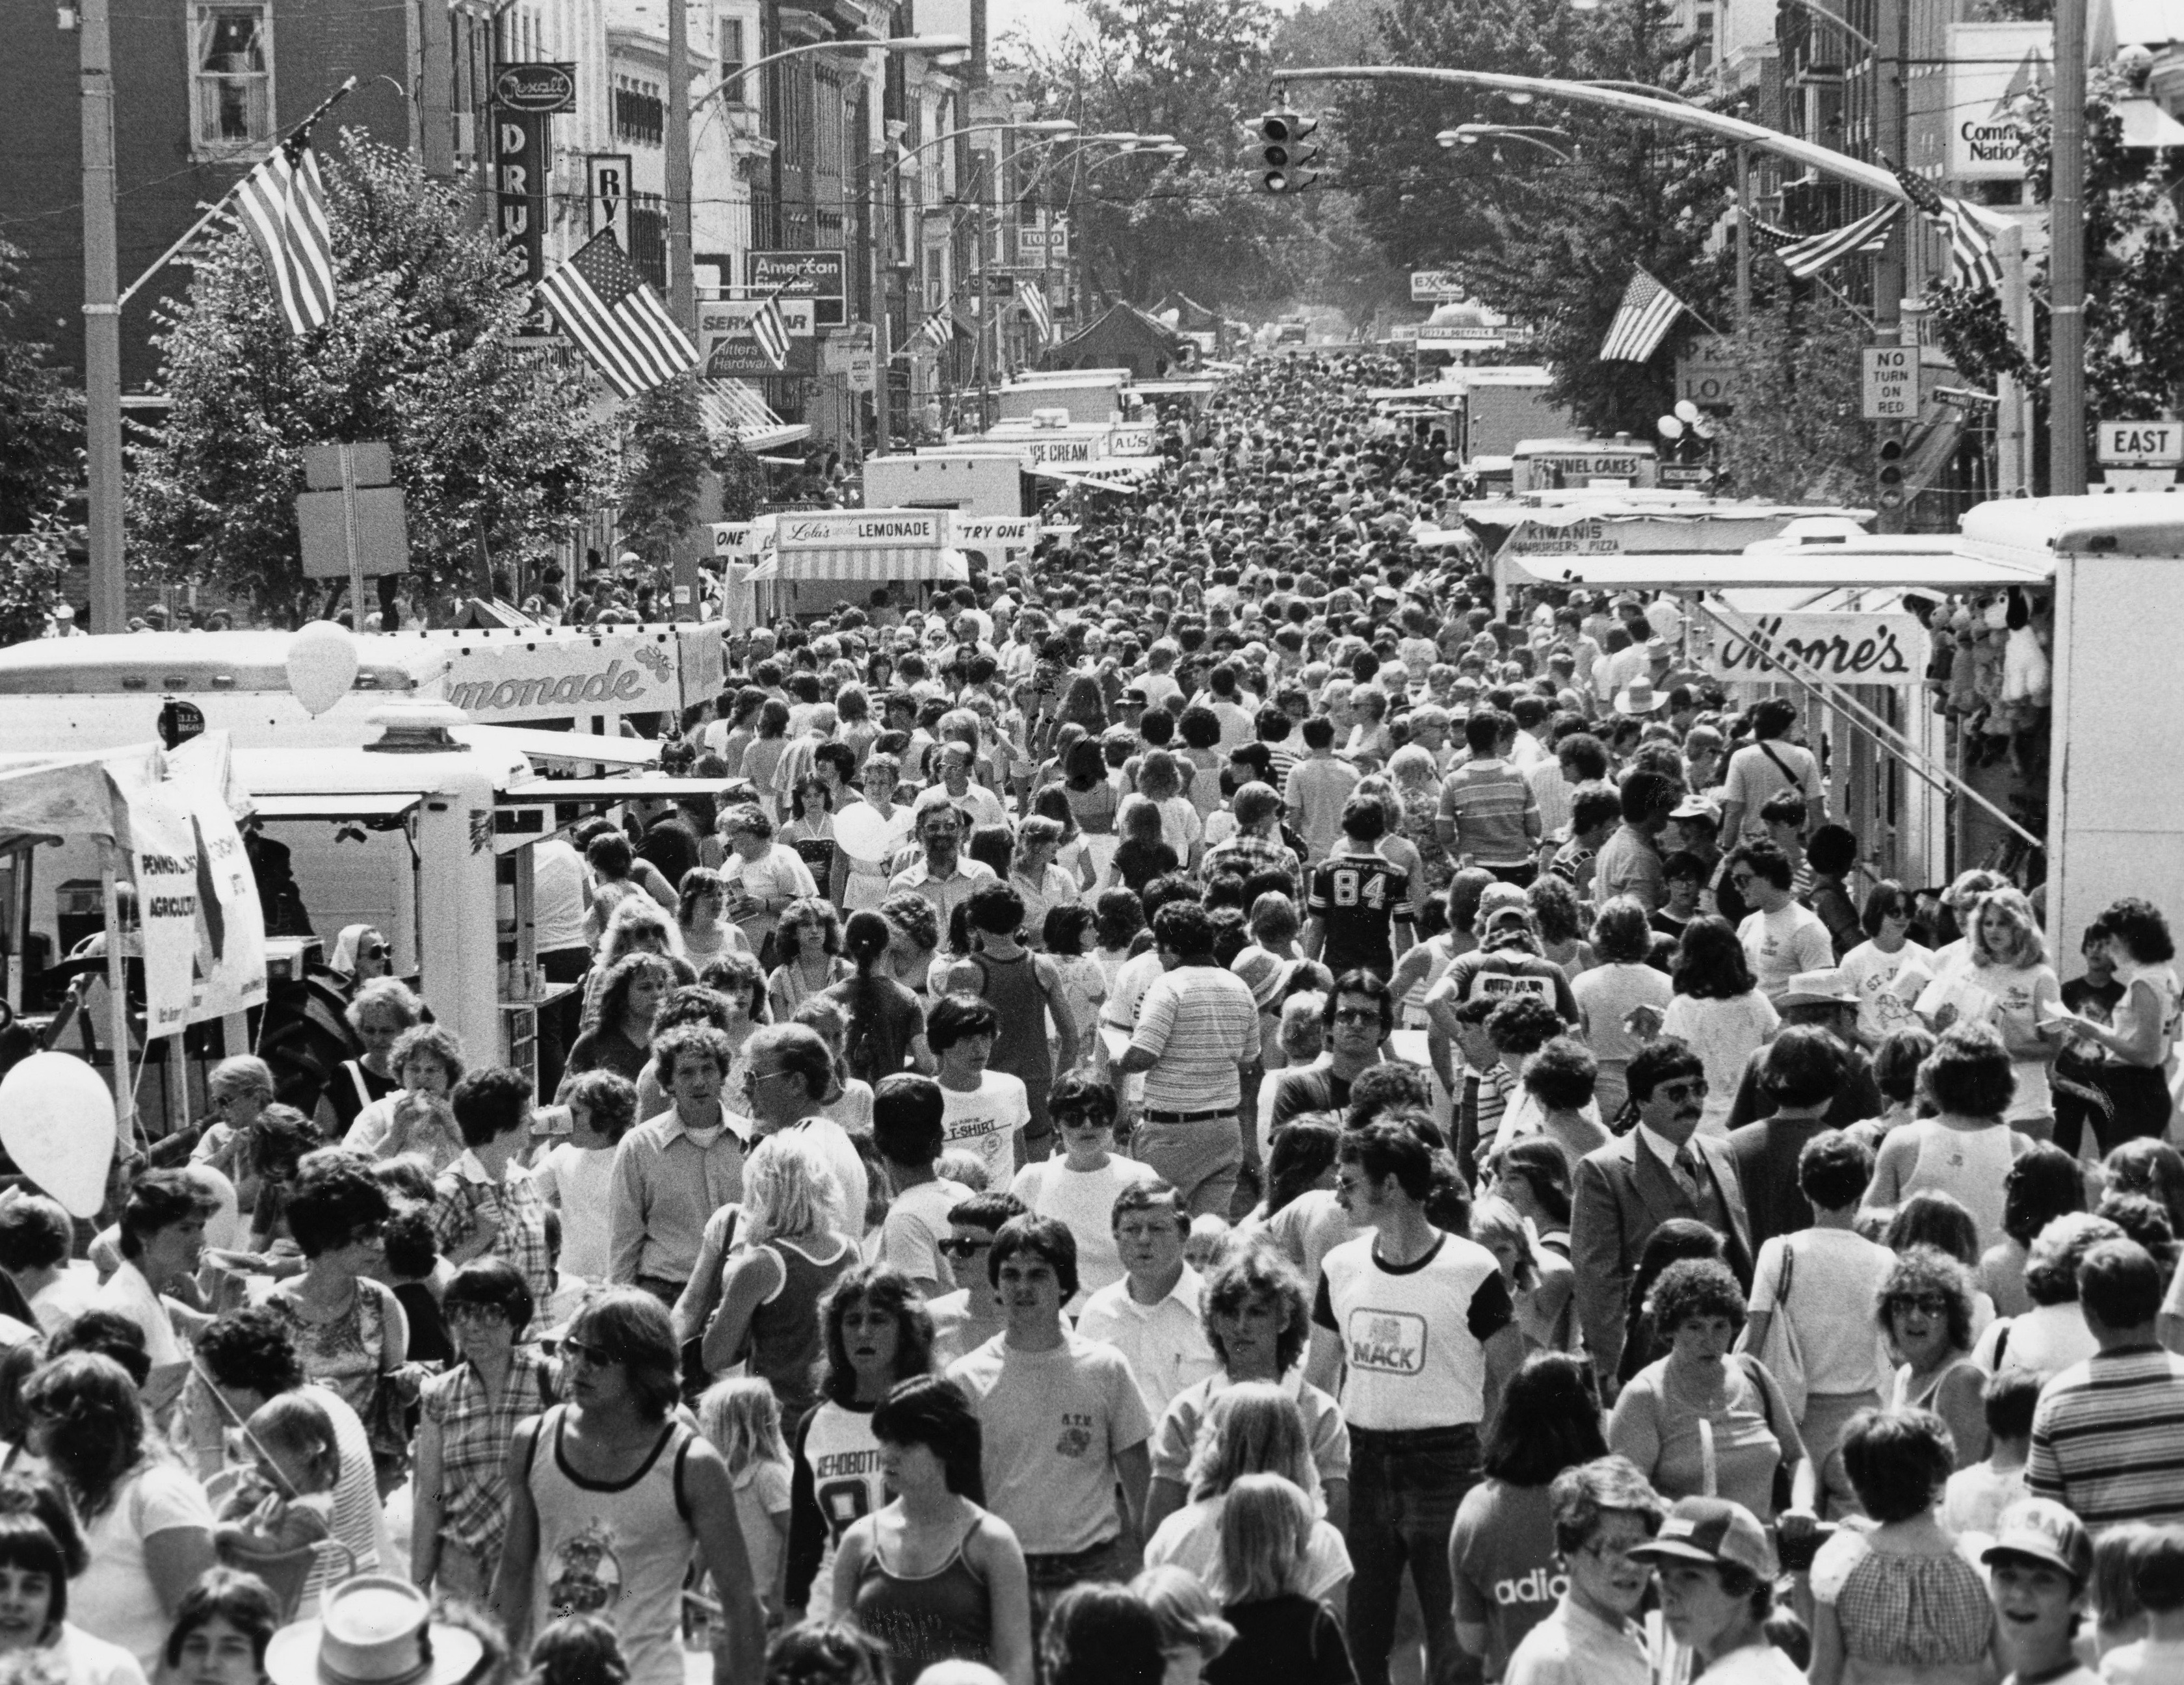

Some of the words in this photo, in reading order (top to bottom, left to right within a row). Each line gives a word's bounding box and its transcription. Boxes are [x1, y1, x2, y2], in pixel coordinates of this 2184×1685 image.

[502, 76, 566, 98] Rexall
[756, 257, 838, 274] American
[703, 315, 806, 330] SERVAR
[717, 346, 757, 356] Ritters
[715, 358, 771, 370] Hardwar
[1877, 352, 1904, 367] NO
[1874, 370, 1908, 382] TURN
[1882, 386, 1901, 397] ON
[1878, 401, 1904, 413] RED
[1115, 434, 1148, 449] AL'S
[2114, 430, 2169, 452] EAST
[1049, 443, 1088, 462] CREAM
[1595, 458, 1637, 474] CAKES
[787, 522, 830, 541] Lola's
[858, 522, 930, 538] LEMONADE
[1529, 525, 1602, 540] KIWANIS
[1588, 539, 1619, 552] PIZZA
[1722, 616, 1910, 673] Moore's
[1334, 869, 1386, 910] 84
[1866, 974, 1882, 991] ST
[949, 1119, 995, 1140] T-SHIRT
[1353, 1342, 1415, 1370] MACK
